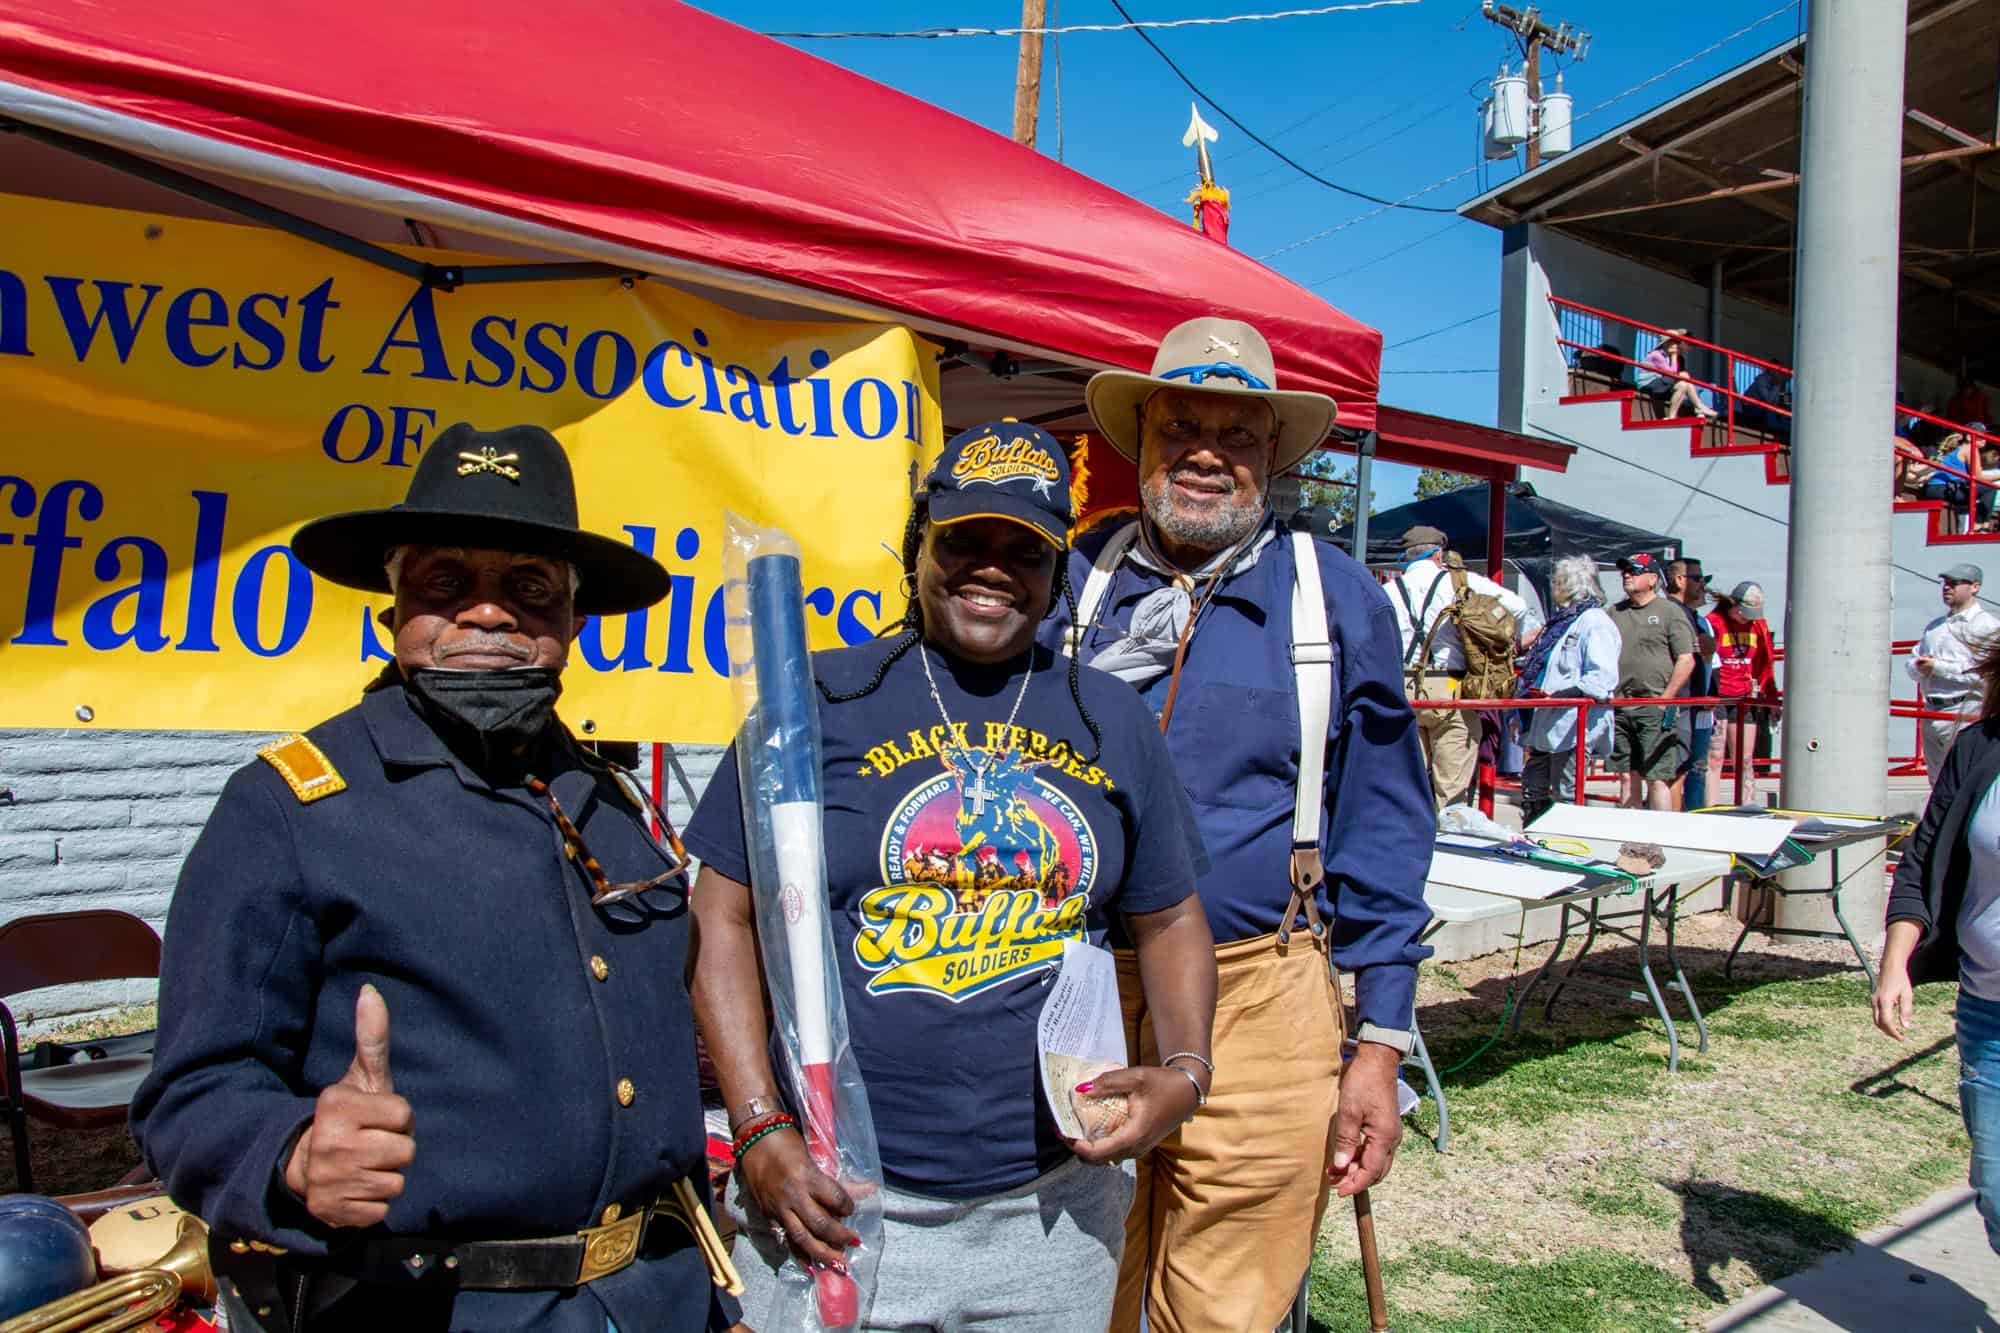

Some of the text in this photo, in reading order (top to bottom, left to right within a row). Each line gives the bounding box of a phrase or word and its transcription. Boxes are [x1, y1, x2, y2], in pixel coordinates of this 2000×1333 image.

[361, 279, 923, 447] Association
[321, 403, 436, 467] OF
[952, 435, 1058, 476] Buffalo
[990, 463, 1031, 478] SOLDIERS
[864, 721, 1106, 785] BLACK HEROES
[1041, 789, 1062, 806] WE
[888, 836, 902, 880] READY
[900, 780, 949, 823] FORWARD
[1079, 834, 1092, 855] WE
[1078, 857, 1093, 887] WILL
[943, 946, 1031, 985] SOLDIERS
